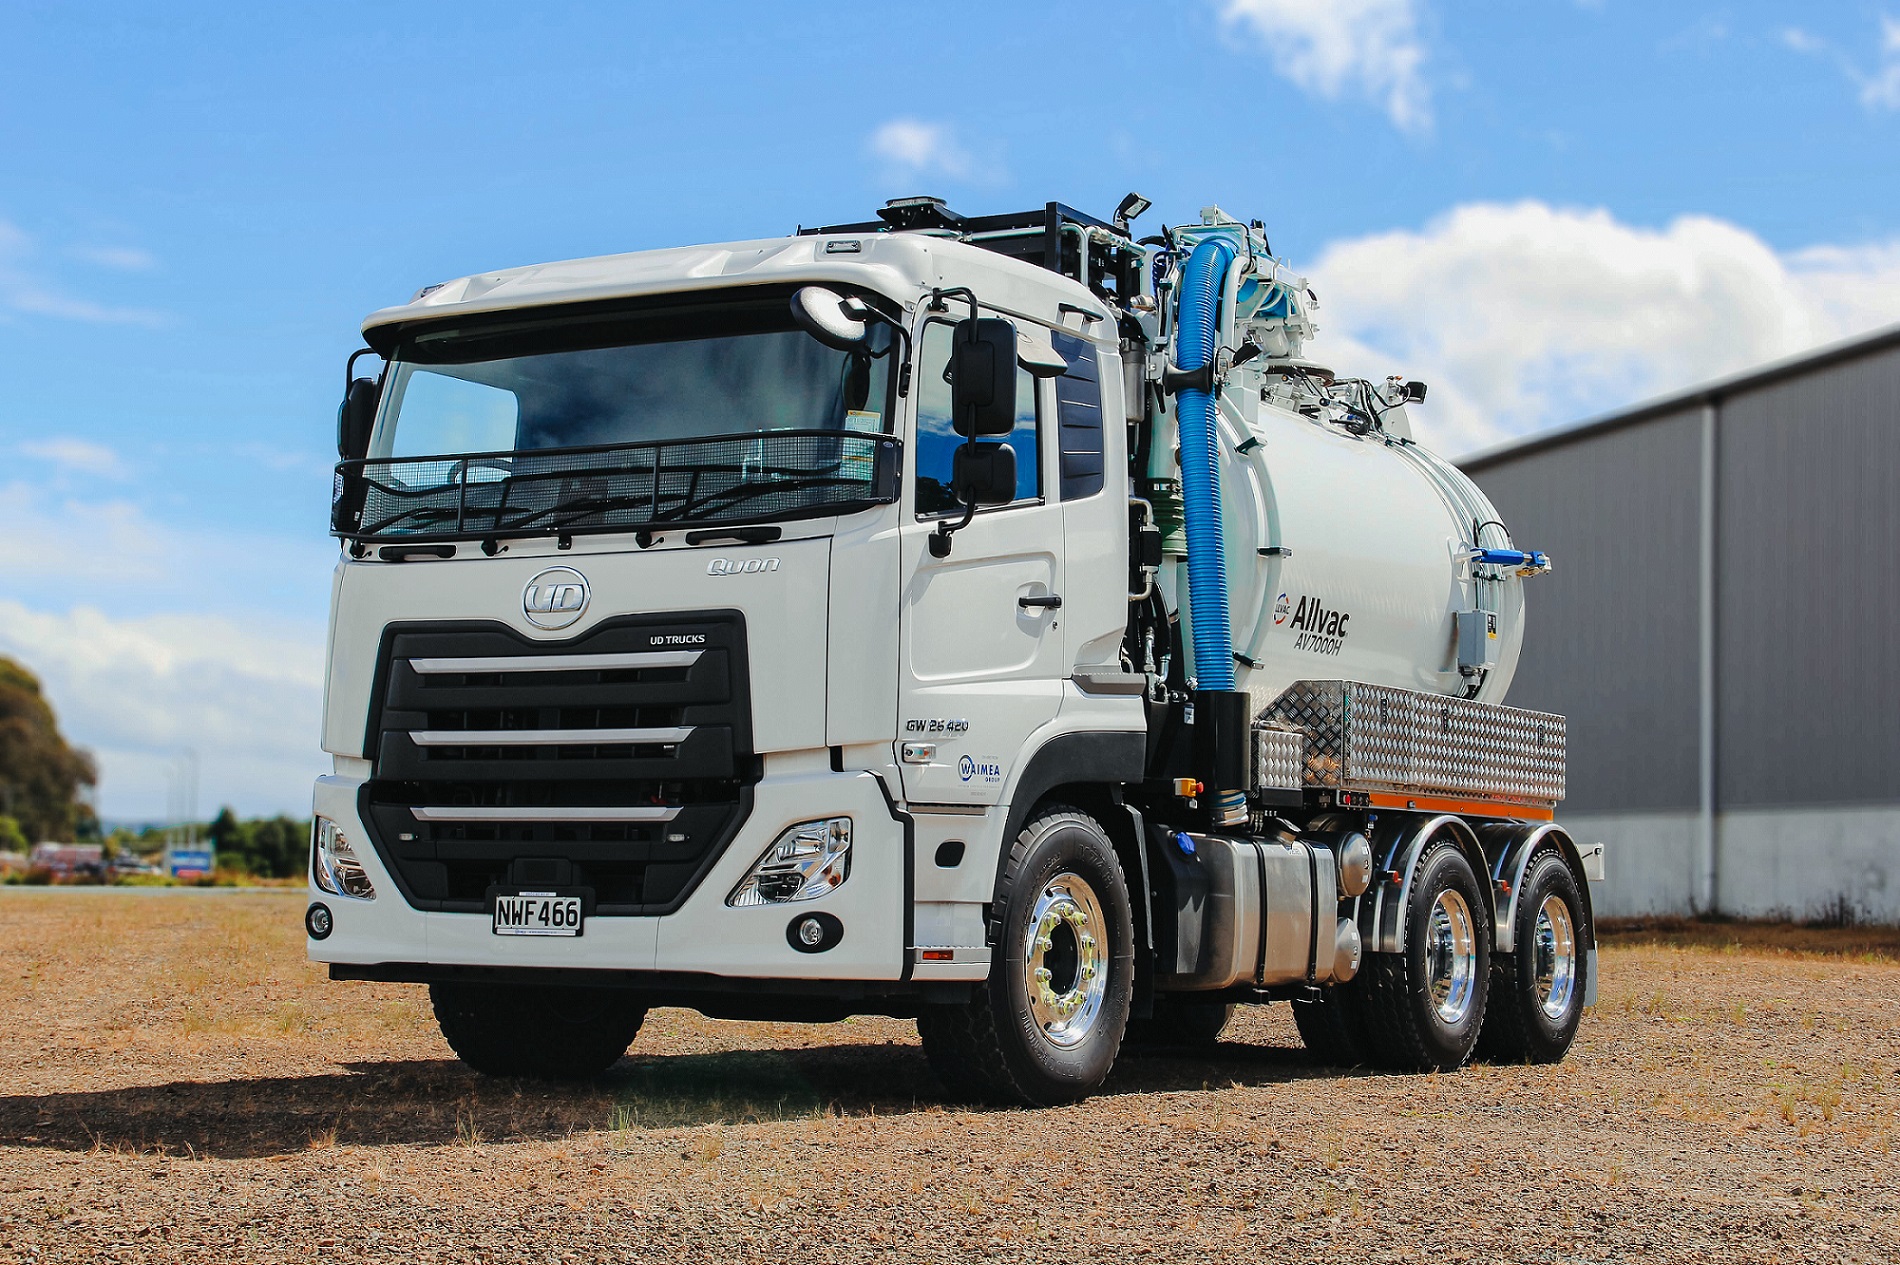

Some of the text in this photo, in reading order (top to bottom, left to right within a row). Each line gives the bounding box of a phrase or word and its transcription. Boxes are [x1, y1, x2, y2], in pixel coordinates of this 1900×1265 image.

[706, 557, 781, 576] Quon
[526, 584, 585, 613] UD
[1289, 595, 1350, 638] Allvac
[650, 634, 706, 645] UD TRUCKS
[1293, 632, 1343, 657] AV7000H
[906, 719, 927, 732] GW
[946, 718, 970, 732] 420
[960, 763, 1001, 776] WAIMEA
[497, 900, 579, 927] NWF466
